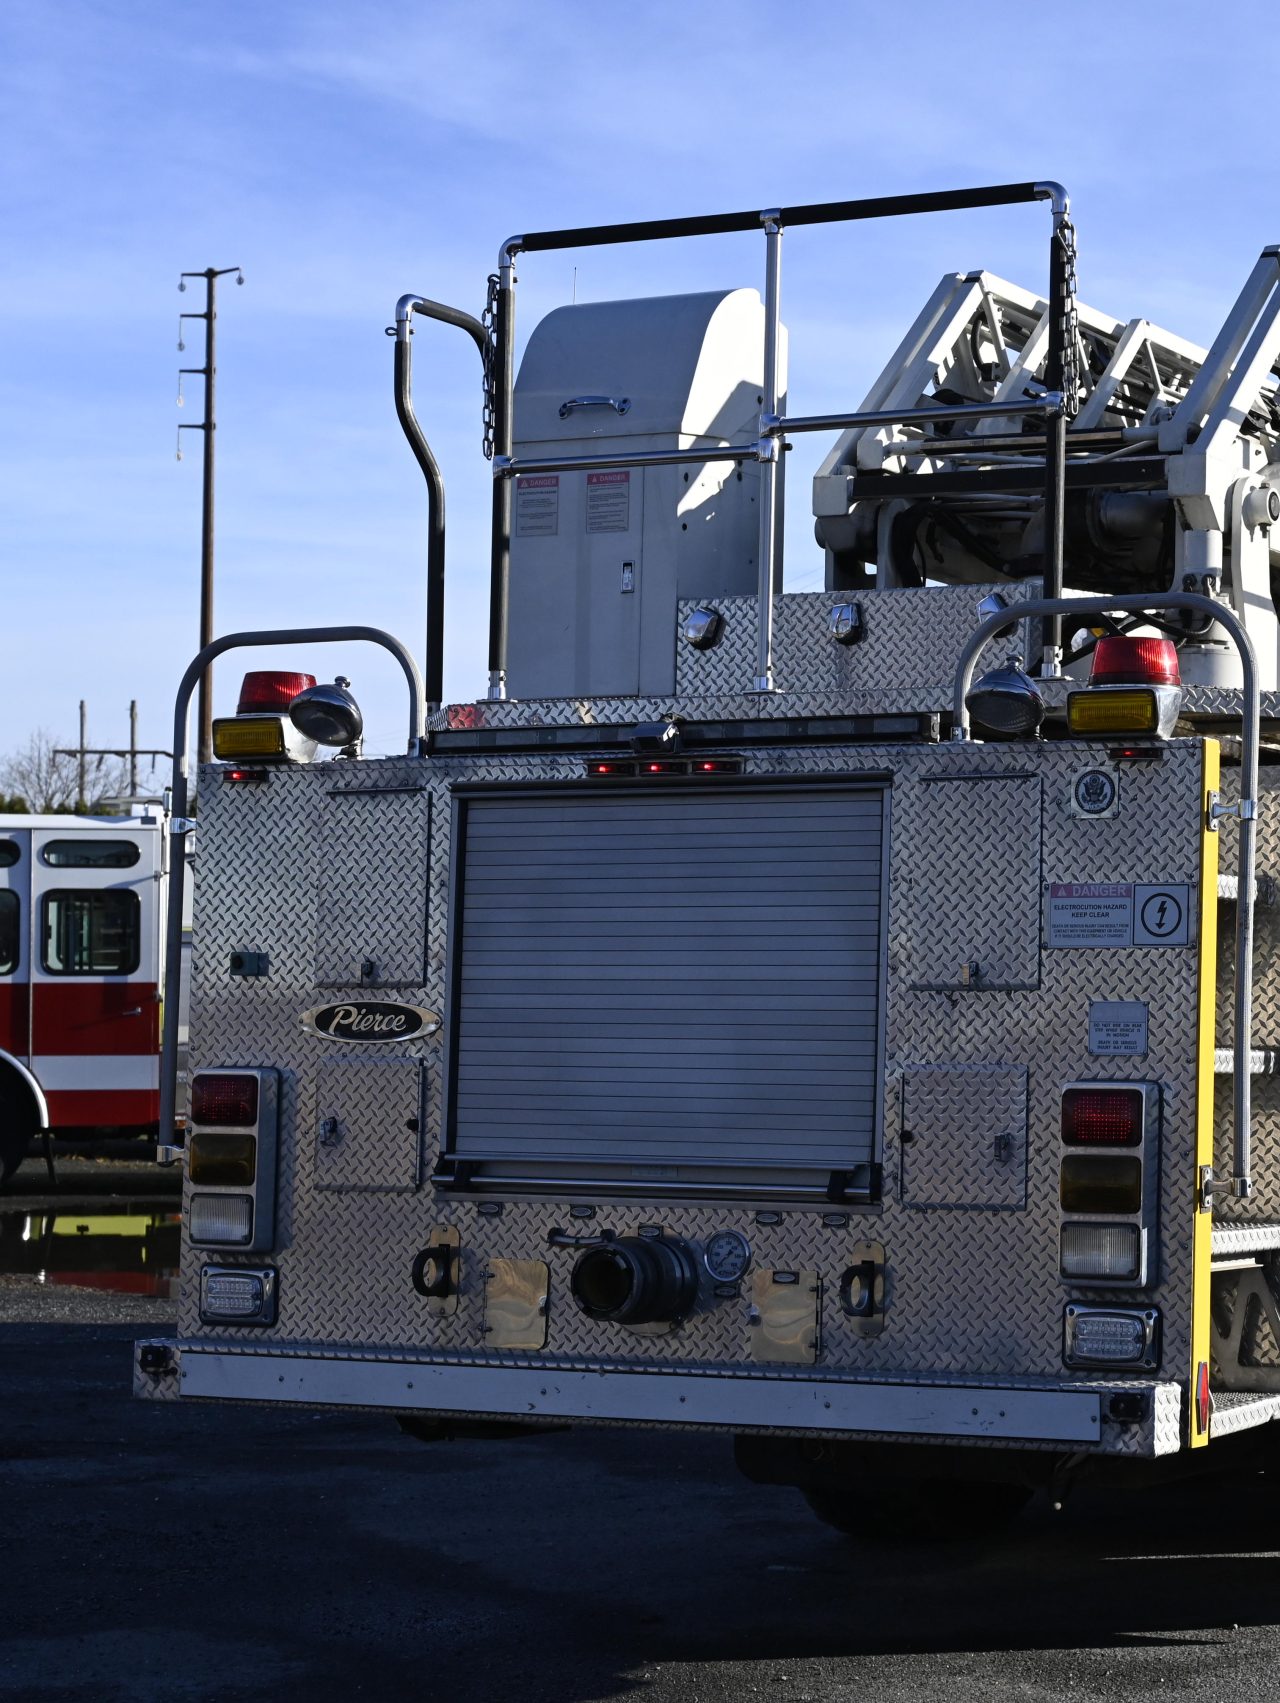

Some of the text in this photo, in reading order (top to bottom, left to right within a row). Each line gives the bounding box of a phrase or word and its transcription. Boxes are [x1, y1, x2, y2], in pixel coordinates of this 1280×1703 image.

[529, 478, 557, 487] DANGER
[1072, 885, 1127, 897] DANGER
[328, 1005, 407, 1036] Pierce
